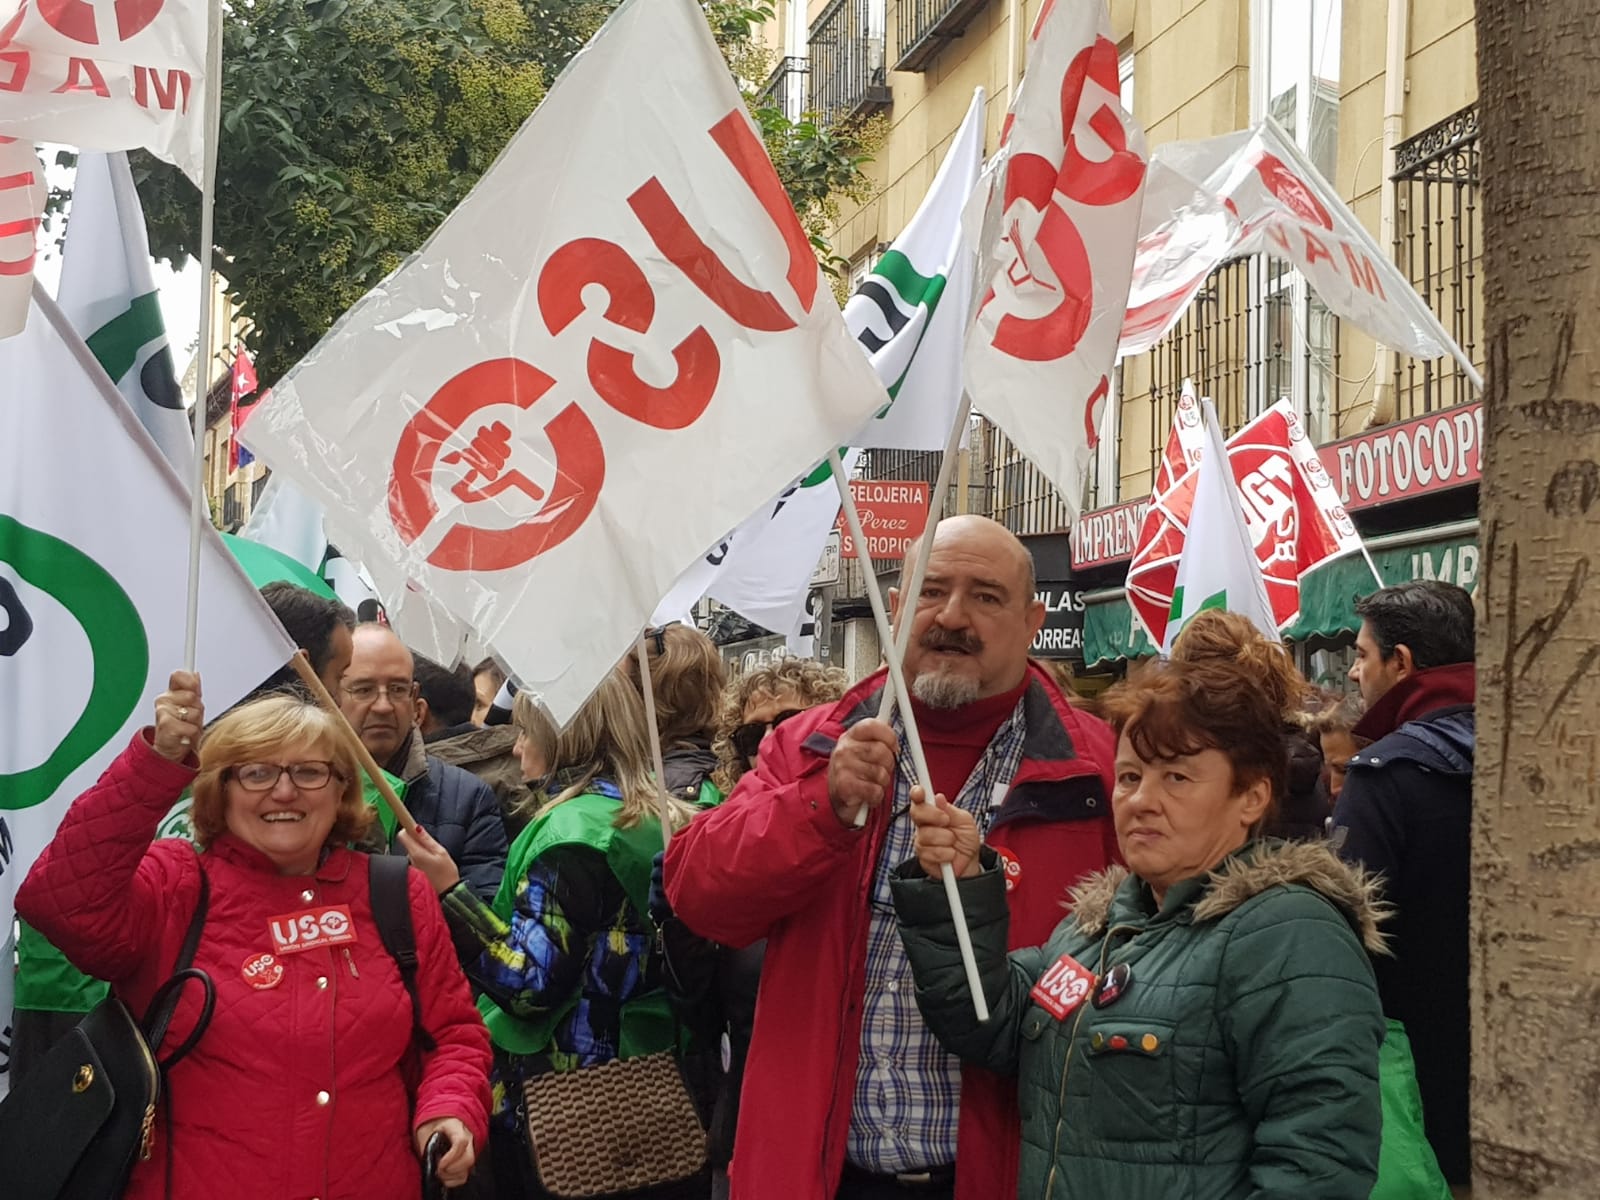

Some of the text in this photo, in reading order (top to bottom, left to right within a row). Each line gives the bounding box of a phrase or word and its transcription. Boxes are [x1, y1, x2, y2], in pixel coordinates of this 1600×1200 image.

[849, 485, 923, 504] RELOJERIA
[856, 508, 909, 530] Perez
[1074, 502, 1151, 565] IMPRENT
[1411, 545, 1480, 590] IMP
[1030, 627, 1085, 650] ORREA
[272, 910, 349, 945] USO
[243, 954, 274, 977] USO
[1040, 959, 1089, 1005] USO
